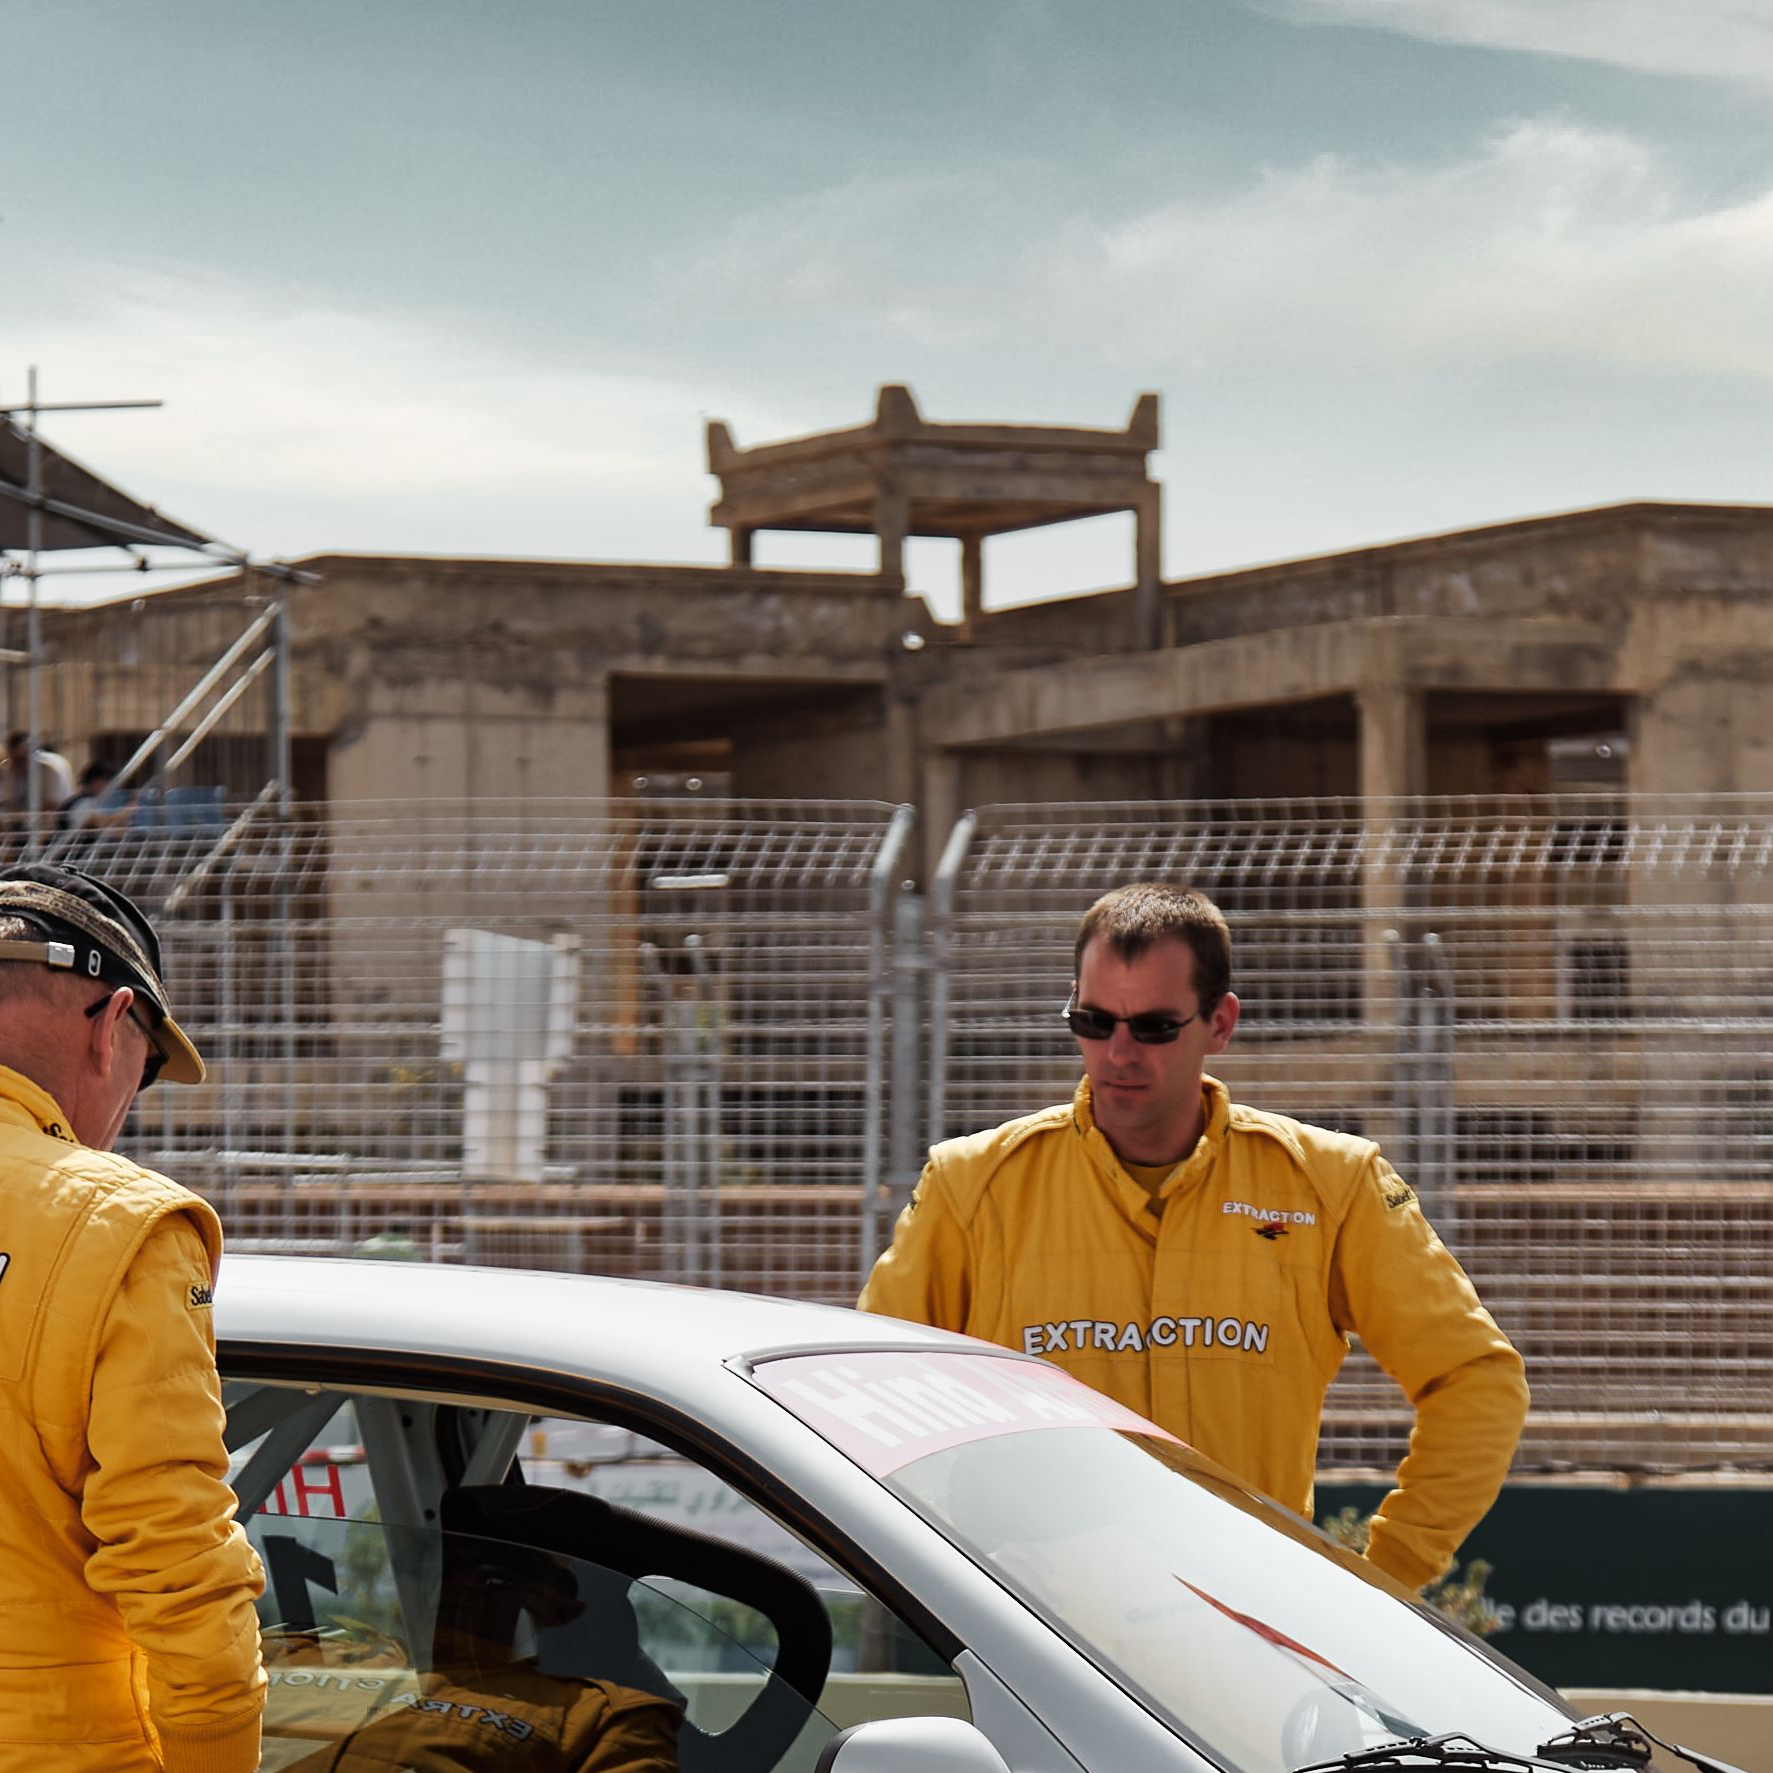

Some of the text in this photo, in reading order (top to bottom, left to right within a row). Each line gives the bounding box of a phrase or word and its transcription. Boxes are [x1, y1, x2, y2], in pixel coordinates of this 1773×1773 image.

[1222, 1201, 1316, 1226] EXTRACTION
[1022, 1316, 1269, 1355] EXTRACTION
[1521, 1598, 1582, 1630] des
[1589, 1599, 1717, 1632] records
[1721, 1600, 1770, 1633] du
